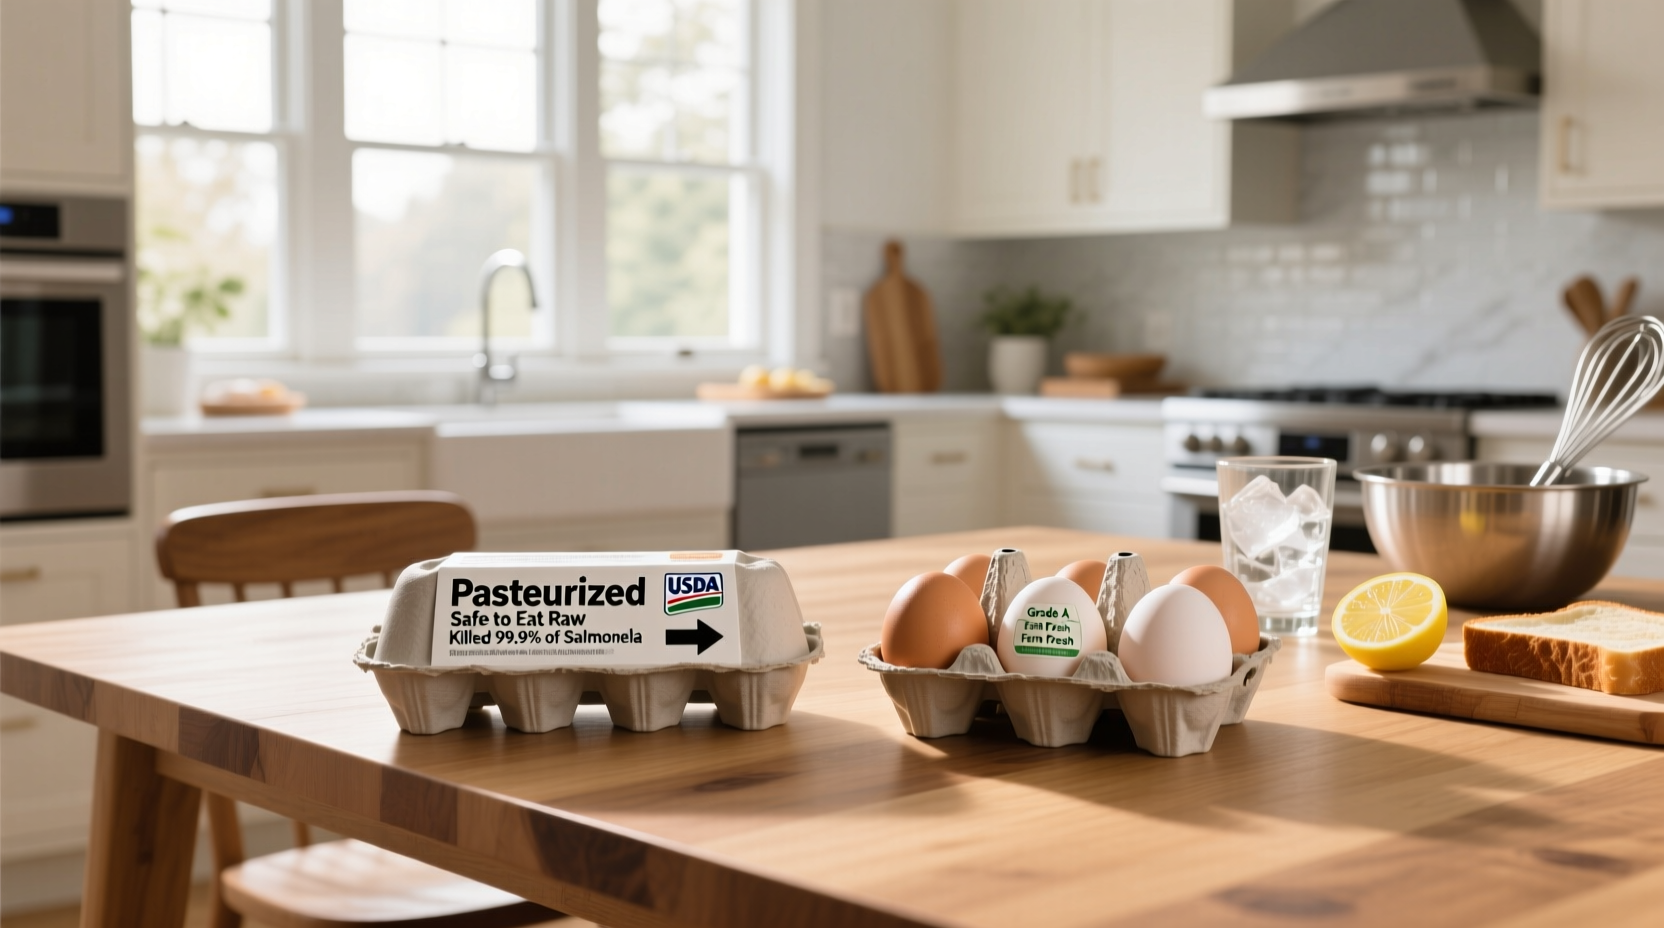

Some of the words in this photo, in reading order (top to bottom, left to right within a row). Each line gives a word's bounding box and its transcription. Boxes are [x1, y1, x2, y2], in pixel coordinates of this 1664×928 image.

[451, 575, 646, 607] Pasteurized
[668, 575, 720, 595] USDA
[450, 611, 490, 627] Safe
[493, 612, 512, 627] to
[516, 612, 545, 627] Eat
[549, 611, 586, 627] Raw
[1027, 606, 1059, 618] Grade
[1061, 607, 1069, 619] A
[449, 630, 491, 645] Killed
[495, 630, 542, 645] 99.9%
[545, 629, 561, 644] of
[563, 628, 643, 645] Salmonela
